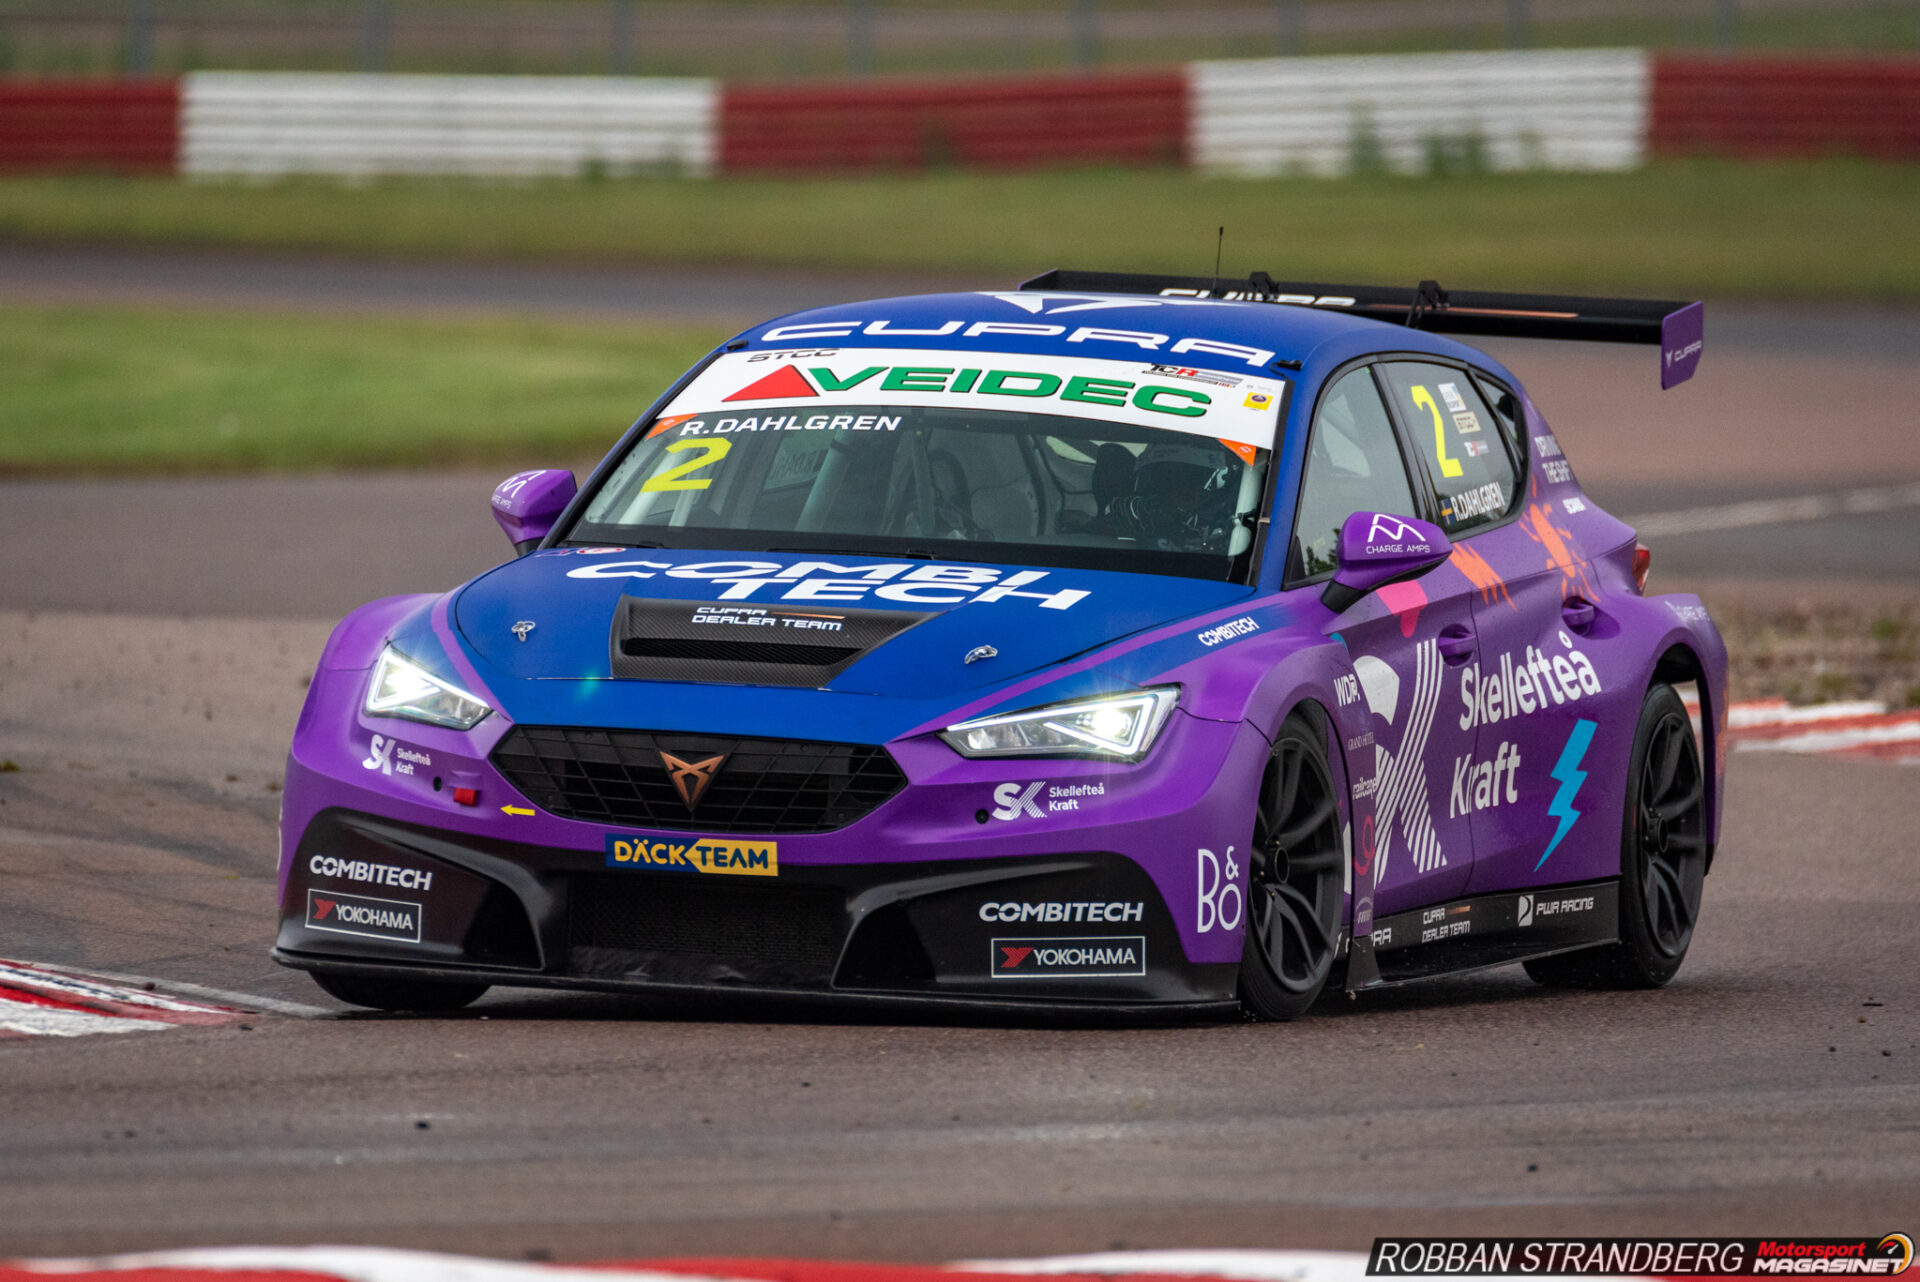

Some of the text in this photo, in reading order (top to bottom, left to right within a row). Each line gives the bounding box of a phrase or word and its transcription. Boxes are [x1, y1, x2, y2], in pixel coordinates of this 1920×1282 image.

[761, 320, 1276, 367] CUPRA
[1151, 363, 1199, 376] TCR
[808, 366, 1212, 418] VEIDEC
[680, 416, 902, 437] R.DAHLGREN
[1410, 385, 1464, 478] 2
[640, 437, 733, 493] 2
[1366, 544, 1431, 555] CHARGE AMPS
[566, 560, 1051, 586] COMBI
[711, 578, 1092, 610] TECH
[691, 614, 842, 632] DEALER TEAM
[697, 606, 768, 616] CUPRA
[1198, 616, 1260, 646] COMBITECH
[1458, 631, 1602, 731] Skellefteå
[1049, 782, 1105, 798] Skellefteå
[1449, 741, 1521, 819] Kraft
[1049, 799, 1079, 811] Kraft
[613, 838, 769, 869] DÄCK TEAM
[309, 854, 433, 891] COMBITECH
[335, 903, 414, 930] YOKOHAMA
[978, 902, 1144, 922] COMBITECH
[1423, 908, 1446, 925] CUPRA
[1536, 897, 1595, 916] PWR RACING
[1422, 920, 1471, 943] DEALER TEAM
[1033, 948, 1137, 965] YOKOHAMA
